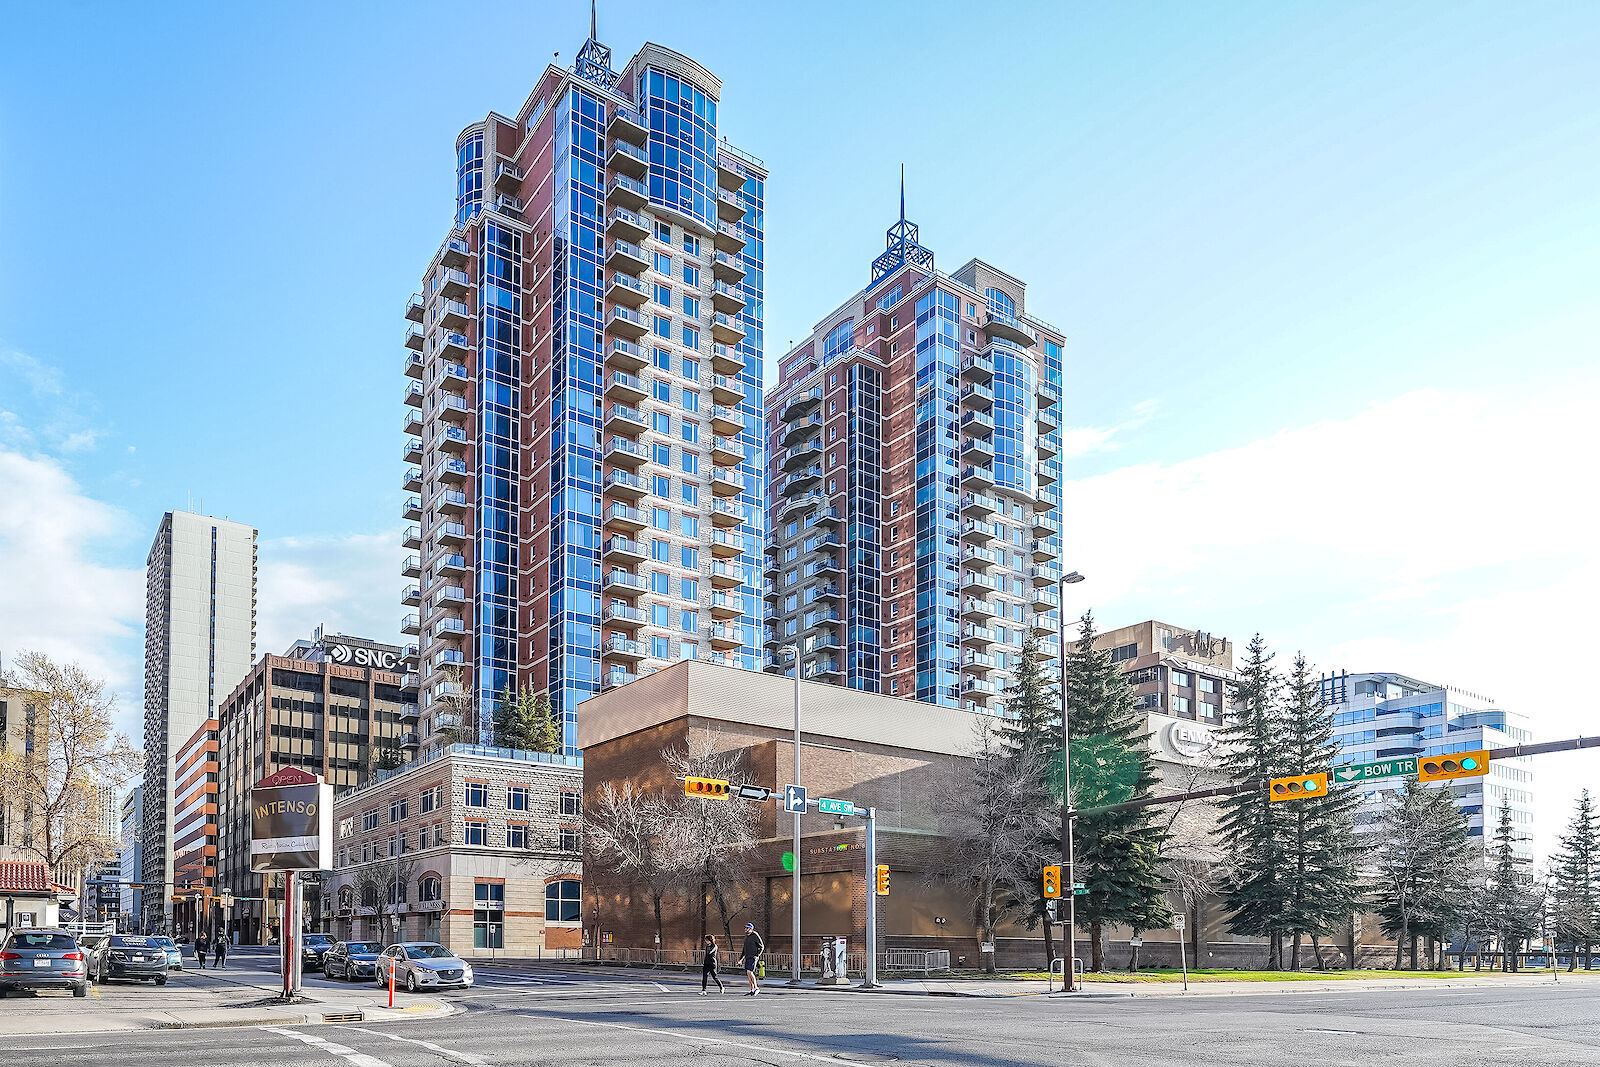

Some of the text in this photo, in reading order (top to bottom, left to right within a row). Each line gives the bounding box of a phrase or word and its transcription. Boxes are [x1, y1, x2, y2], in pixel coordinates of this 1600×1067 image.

[1364, 760, 1414, 777] BOW TR
[272, 775, 302, 785] OPEN
[254, 800, 317, 820] INTENSO
[821, 801, 853, 812] 4 AVE SW
